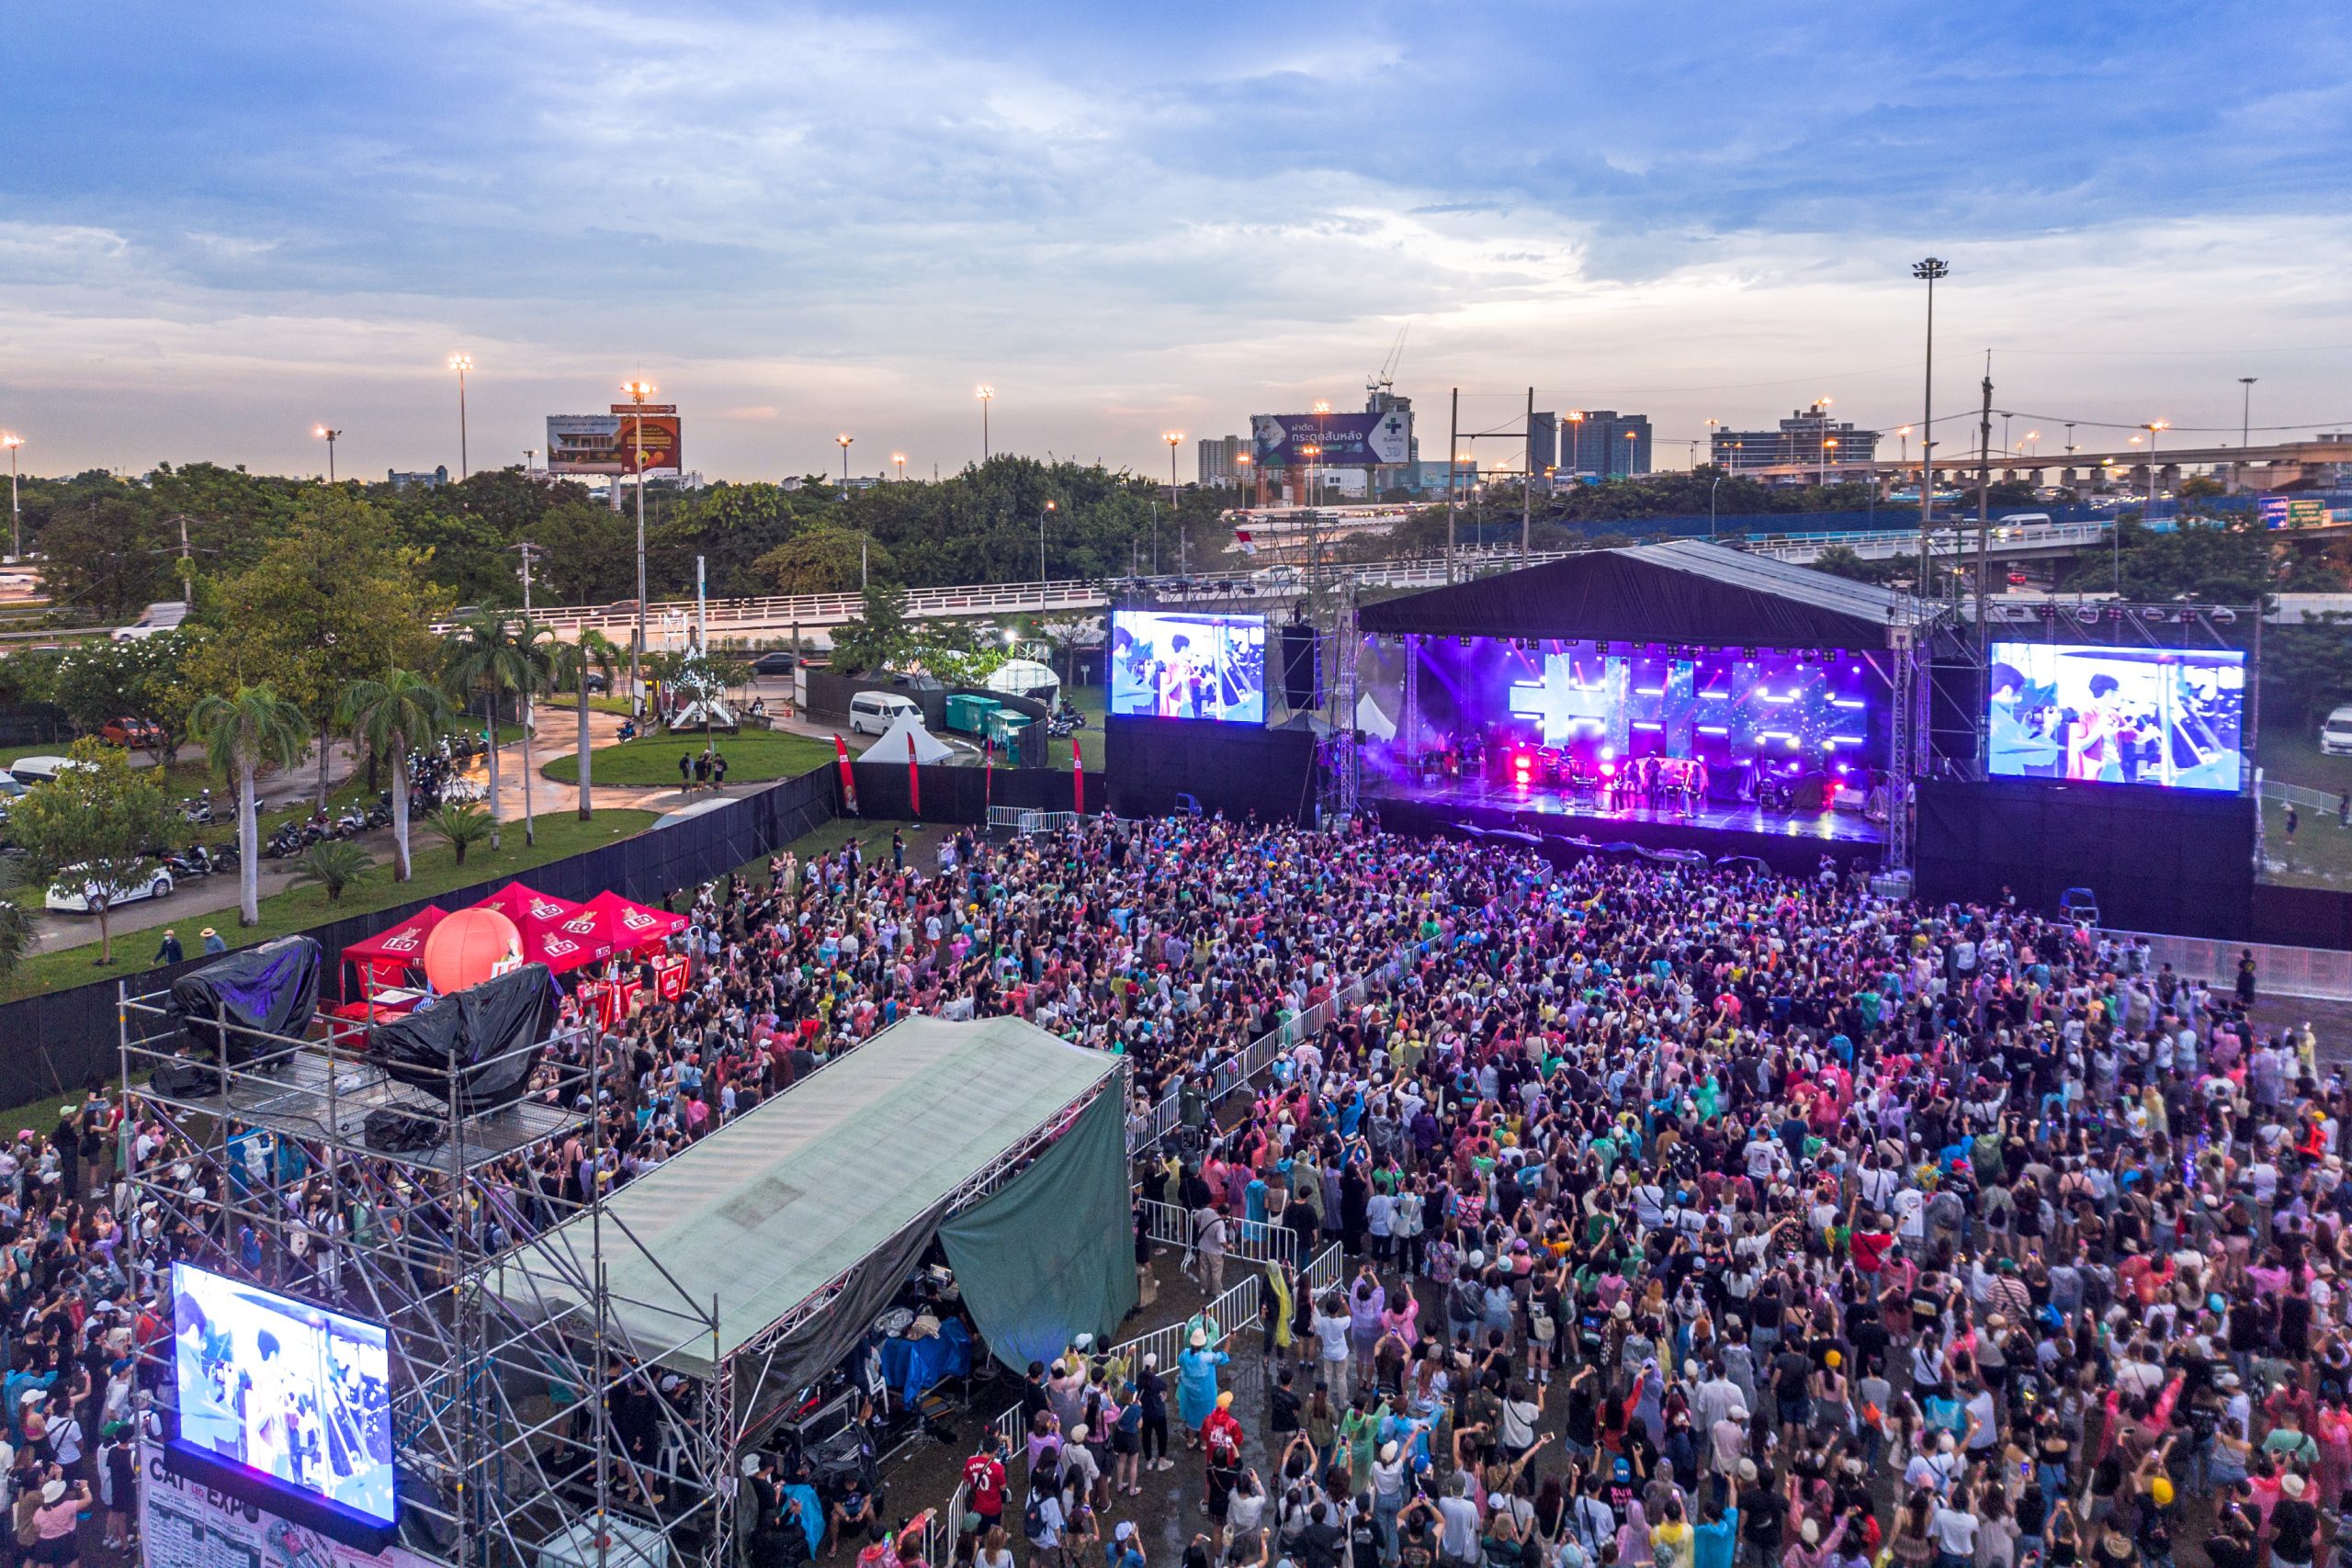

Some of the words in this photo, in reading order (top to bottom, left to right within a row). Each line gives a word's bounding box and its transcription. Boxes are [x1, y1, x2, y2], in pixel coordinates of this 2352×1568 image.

[1292, 430, 1363, 445] กระดูกสันหลัง
[535, 905, 560, 918] LEO
[564, 921, 592, 932] LEO
[628, 915, 653, 928] LEO
[673, 919, 684, 930] LEO
[385, 939, 415, 950] LEO
[548, 941, 576, 954] LEO
[597, 946, 610, 956] LEO
[973, 1472, 989, 1491] 10
[149, 1457, 184, 1490] CAT
[207, 1488, 259, 1524] EXPO
